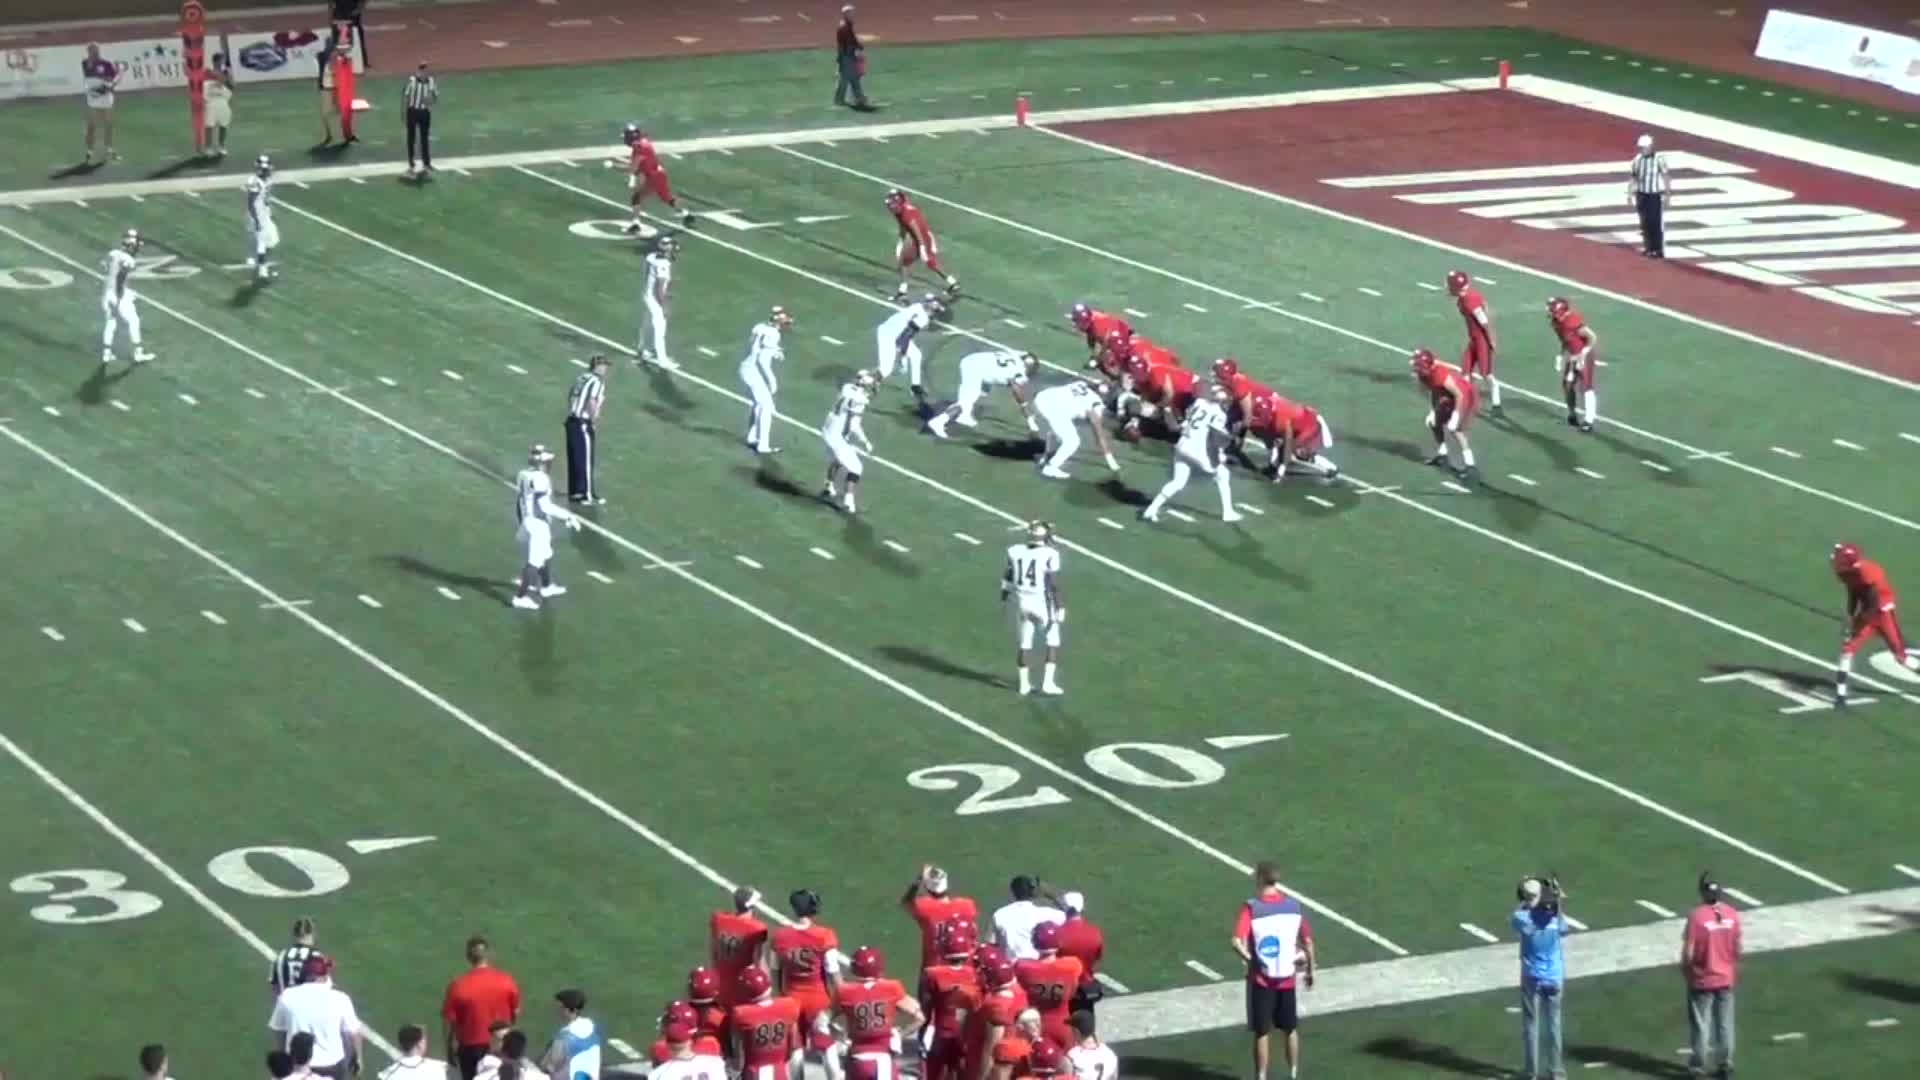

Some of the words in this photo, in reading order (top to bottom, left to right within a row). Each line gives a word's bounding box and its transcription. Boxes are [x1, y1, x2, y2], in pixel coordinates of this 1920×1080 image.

[1017, 557, 1037, 587] 14
[906, 743, 1226, 815] 20
[10, 846, 350, 923] 30
[287, 961, 304, 985] F
[757, 1020, 786, 1046] 88
